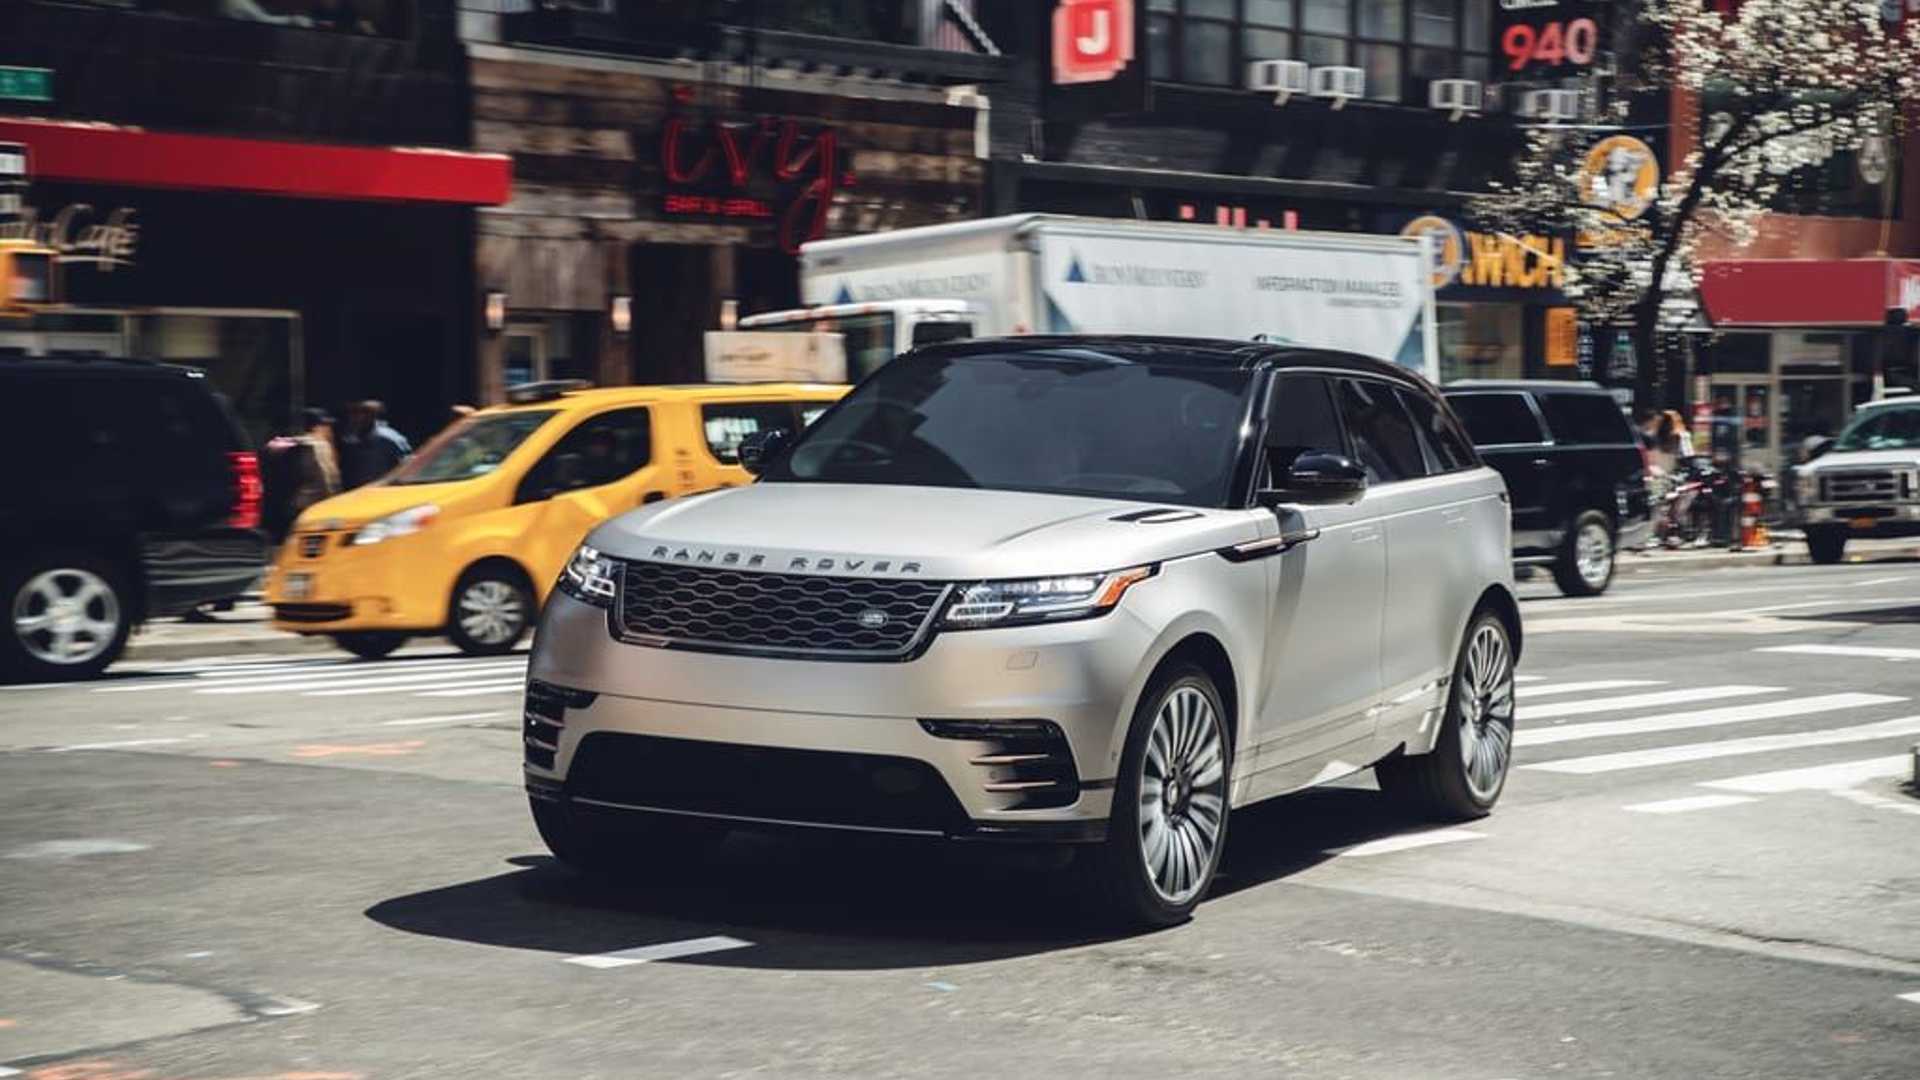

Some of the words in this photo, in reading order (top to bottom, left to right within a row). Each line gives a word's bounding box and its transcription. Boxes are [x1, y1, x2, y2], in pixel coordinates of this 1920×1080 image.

[1076, 9, 1110, 55] J
[1503, 17, 1597, 71] 940
[652, 545, 767, 567] RANGE
[788, 556, 922, 574] ROVER
